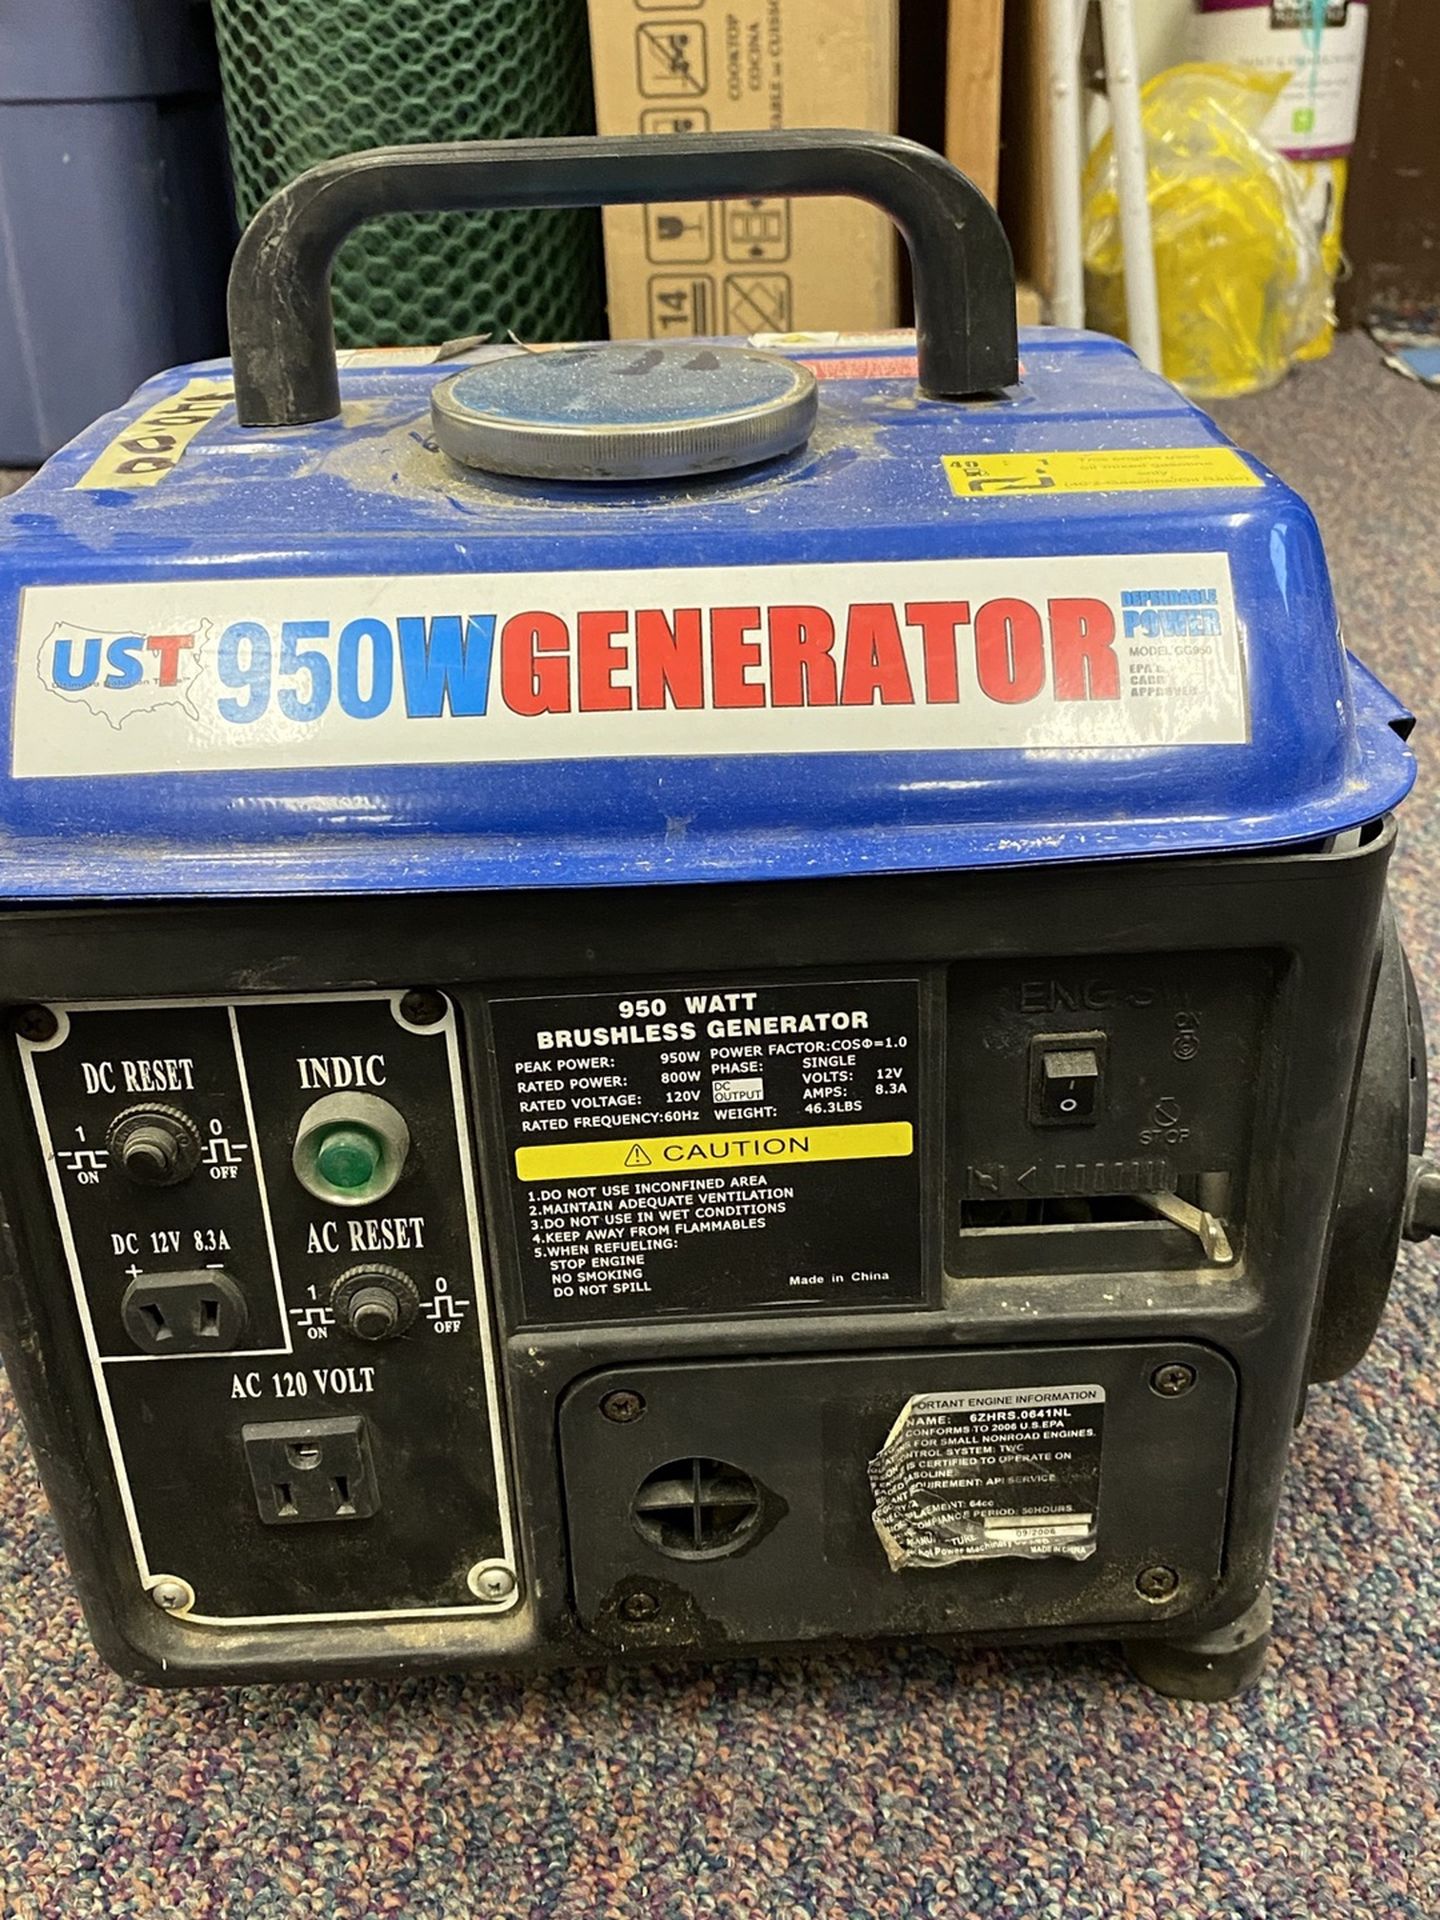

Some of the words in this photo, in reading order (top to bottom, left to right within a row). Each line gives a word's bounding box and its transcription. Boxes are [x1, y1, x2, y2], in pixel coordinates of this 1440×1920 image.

[657, 290, 689, 330] 14
[1121, 589, 1218, 607] DEPENDABLE
[1122, 608, 1222, 638] POWER
[1129, 645, 1172, 657] MODEL
[52, 634, 195, 691] UST
[618, 998, 667, 1018] 950
[685, 992, 757, 1014] WATT
[537, 1021, 697, 1050] BRUSHLESS
[707, 1011, 869, 1039] GENERATOR
[710, 1045, 763, 1059] POWER
[515, 1060, 552, 1074] PEAK
[557, 1057, 615, 1072] POWER:
[660, 1050, 701, 1064] 950W
[711, 1061, 764, 1074] PHASE:
[802, 1055, 856, 1068] SINGLE
[81, 1061, 116, 1094] DC
[121, 1059, 195, 1092] RESET
[297, 1055, 387, 1089] INDIC
[802, 1070, 853, 1084] VOLTS:
[877, 1068, 903, 1080] 12V
[517, 1079, 564, 1093] RATED
[570, 1076, 628, 1090] POWER:
[661, 1071, 701, 1084] 800W
[714, 1081, 731, 1091] DC
[715, 1090, 762, 1101] OUTPUT
[803, 1086, 847, 1100] AMPS:
[875, 1083, 907, 1095] 8.3A
[520, 1099, 566, 1112] RATED
[571, 1094, 642, 1110] VOLTAGE:
[666, 1090, 701, 1103] 120V
[714, 1106, 777, 1120] WEIGHT:
[805, 1101, 862, 1114] 46.3LBS
[522, 1118, 568, 1132] RATED
[663, 1136, 810, 1162] CAUTION
[77, 1170, 100, 1184] ON
[209, 1165, 239, 1179] OFF
[567, 1187, 597, 1199] NOT
[602, 1184, 630, 1197] USE
[635, 1178, 725, 1195] INCONFINED
[730, 1175, 767, 1187] AREA
[619, 1195, 693, 1210] ADEQUATE
[698, 1187, 794, 1204] VENTILATION
[570, 1215, 599, 1227] NOT
[604, 1213, 633, 1225] USE
[637, 1211, 654, 1223] IN
[659, 1209, 689, 1222] WET
[695, 1202, 786, 1219] CONDITIONS
[306, 1221, 339, 1254] AC
[349, 1217, 425, 1251] RESET
[585, 1227, 625, 1241] AWAY
[630, 1224, 669, 1238] FROM
[675, 1218, 766, 1235] FLAMMABLES
[111, 1233, 139, 1255] DC
[150, 1231, 180, 1253] 12V
[194, 1229, 231, 1251] 8.3A
[594, 1238, 678, 1254] REFUELING:
[550, 1259, 586, 1271] STOP
[591, 1254, 645, 1268] ENGINE
[552, 1273, 572, 1285] NO
[577, 1268, 643, 1283] SMOKING
[789, 1274, 824, 1286] Made
[831, 1272, 844, 1283] in
[851, 1269, 889, 1282] China
[554, 1286, 574, 1298] DO
[579, 1283, 608, 1296] NOT
[613, 1280, 652, 1294] SPILL
[307, 1325, 328, 1339] ON
[434, 1320, 461, 1334] OFF
[230, 1373, 261, 1399] AC
[272, 1371, 308, 1397] 120
[313, 1367, 375, 1394] VOLT
[912, 1399, 964, 1410] ORTANT
[968, 1396, 1012, 1407] ENGINE
[1016, 1390, 1096, 1403] INFORMATION
[906, 1416, 951, 1427] NAME:
[970, 1408, 1071, 1422] 6ZHRS.0641NL
[905, 1425, 970, 1437] CONFORMS
[973, 1424, 989, 1433] TO
[991, 1423, 1017, 1432] 2006
[914, 1438, 938, 1448] FOR
[941, 1436, 979, 1446] SMALL
[982, 1432, 1040, 1443] NONROAD
[1043, 1428, 1097, 1439] ENGINES.
[919, 1457, 978, 1468] CERTIFIED
[980, 1456, 996, 1464] TO
[998, 1451, 1052, 1464] OPERATE
[1055, 1451, 1072, 1461] ON
[946, 1446, 996, 1457] SYSTEM:
[1000, 1444, 1024, 1453] TWC
[986, 1477, 1005, 1486] API
[1008, 1474, 1056, 1485] SERVICE
[969, 1500, 994, 1508] 64cc
[1030, 1546, 1051, 1554] MADE
